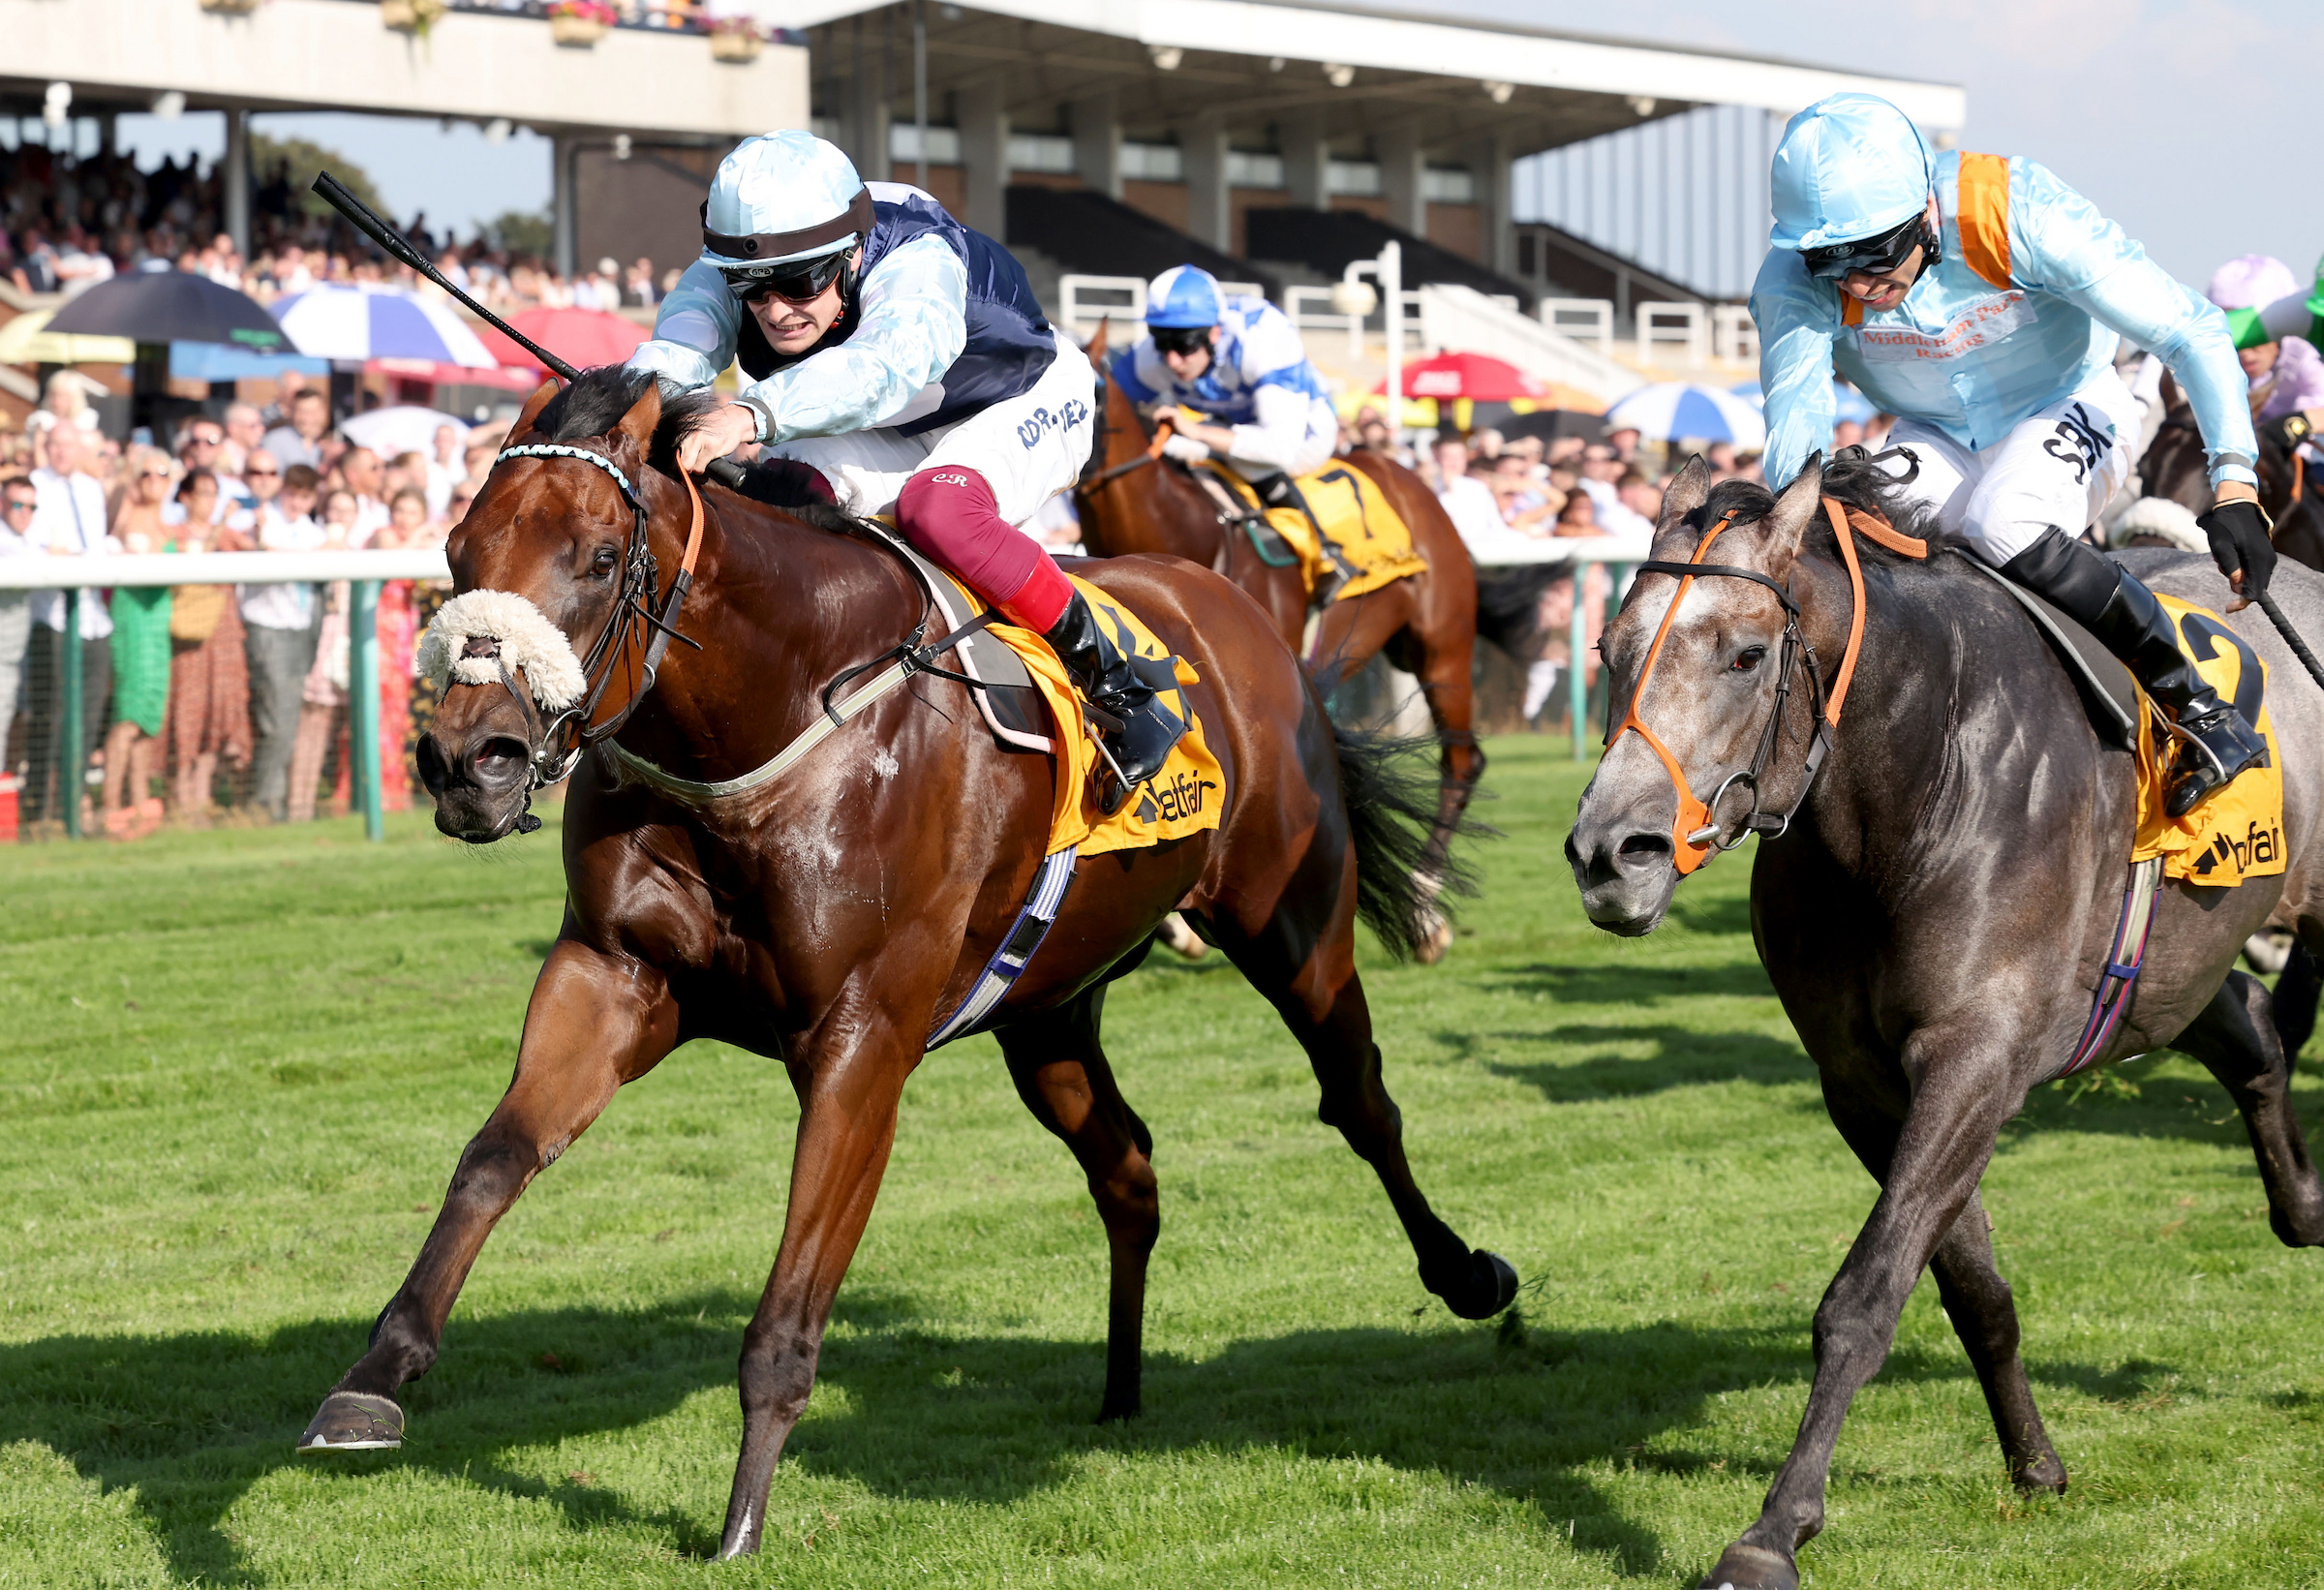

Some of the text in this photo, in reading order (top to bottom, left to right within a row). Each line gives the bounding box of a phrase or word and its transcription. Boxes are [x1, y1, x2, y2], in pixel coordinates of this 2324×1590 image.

[1863, 292, 2024, 348] Middleham Park
[1916, 333, 1985, 359] Racing
[2042, 402, 2113, 485] SBK
[931, 473, 968, 487] CR
[1316, 469, 1373, 539] 7
[2181, 612, 2272, 768] 2
